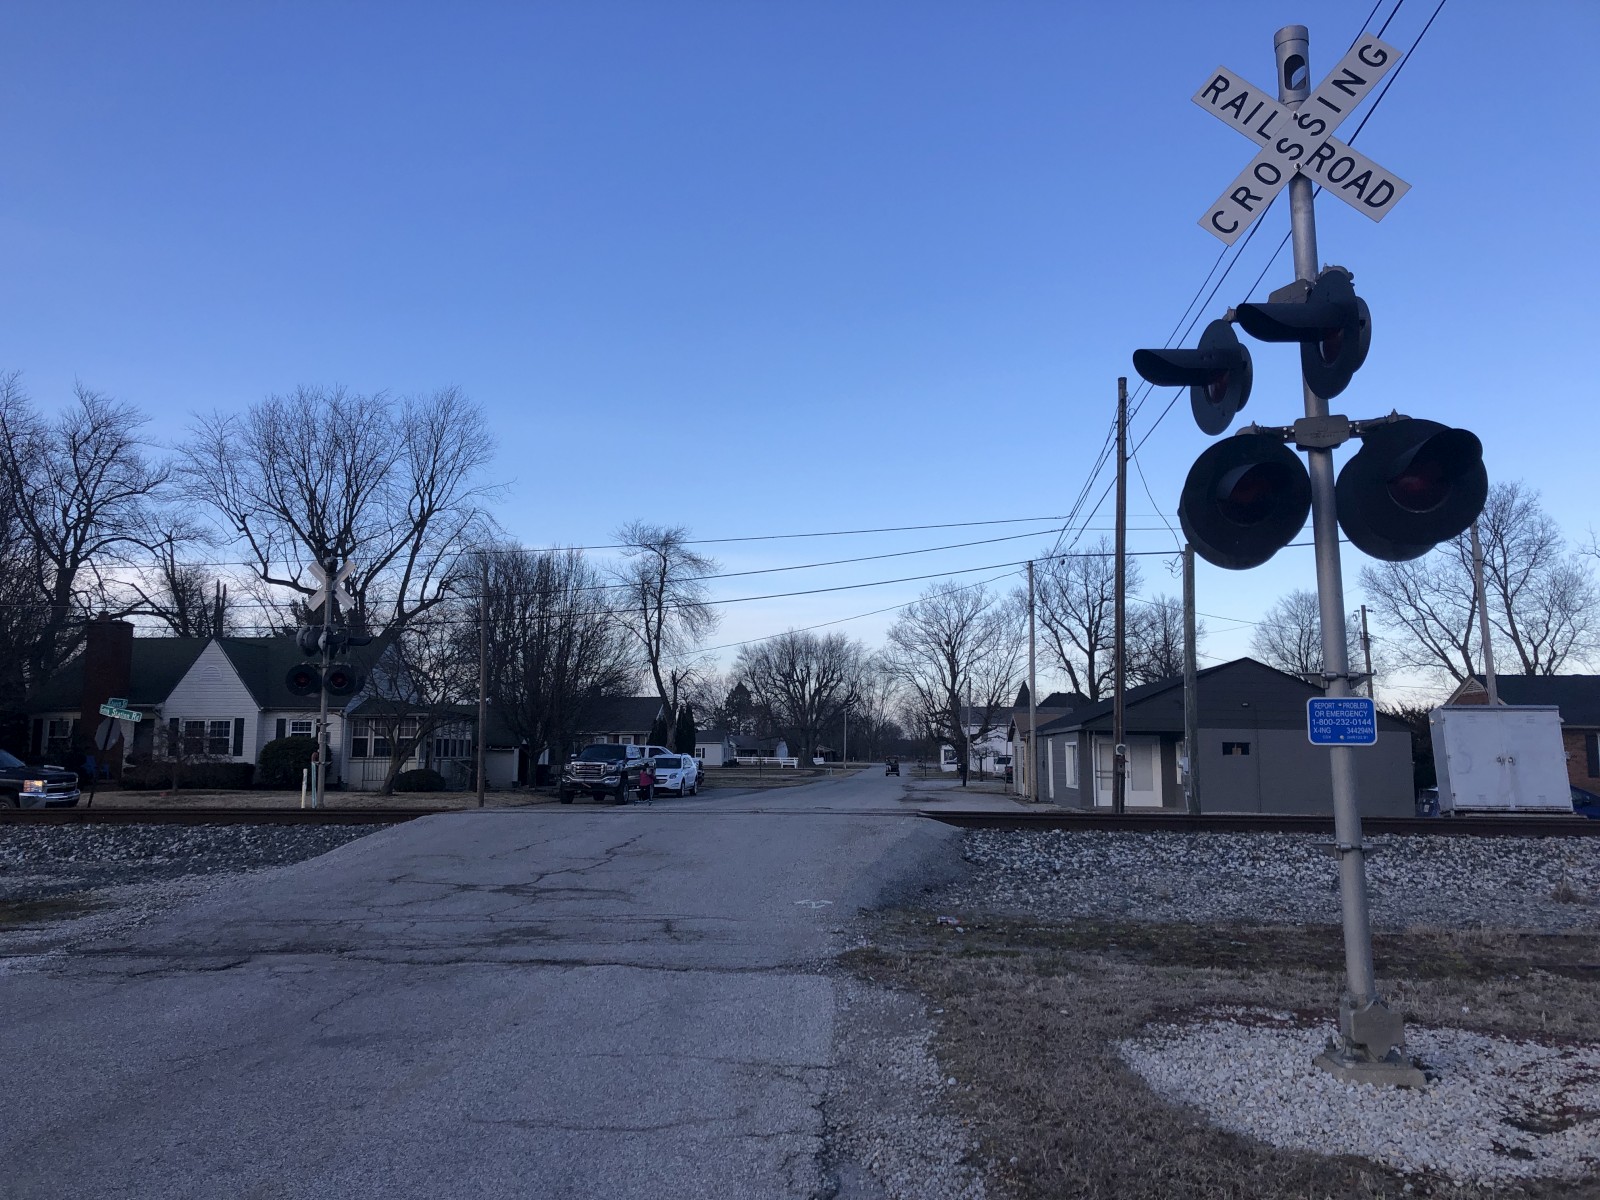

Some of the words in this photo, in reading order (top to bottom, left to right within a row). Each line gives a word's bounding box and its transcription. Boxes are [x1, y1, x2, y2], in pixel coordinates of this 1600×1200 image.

[1201, 74, 1279, 141] RAIL
[1305, 141, 1395, 208] ROAD
[1211, 44, 1388, 234] CROSSING
[111, 708, 130, 719] Station
[131, 712, 140, 721] Rd
[1314, 710, 1325, 718] OR
[1326, 710, 1368, 718] EMERGENCY
[1312, 718, 1372, 726] 1-800-232-0144
